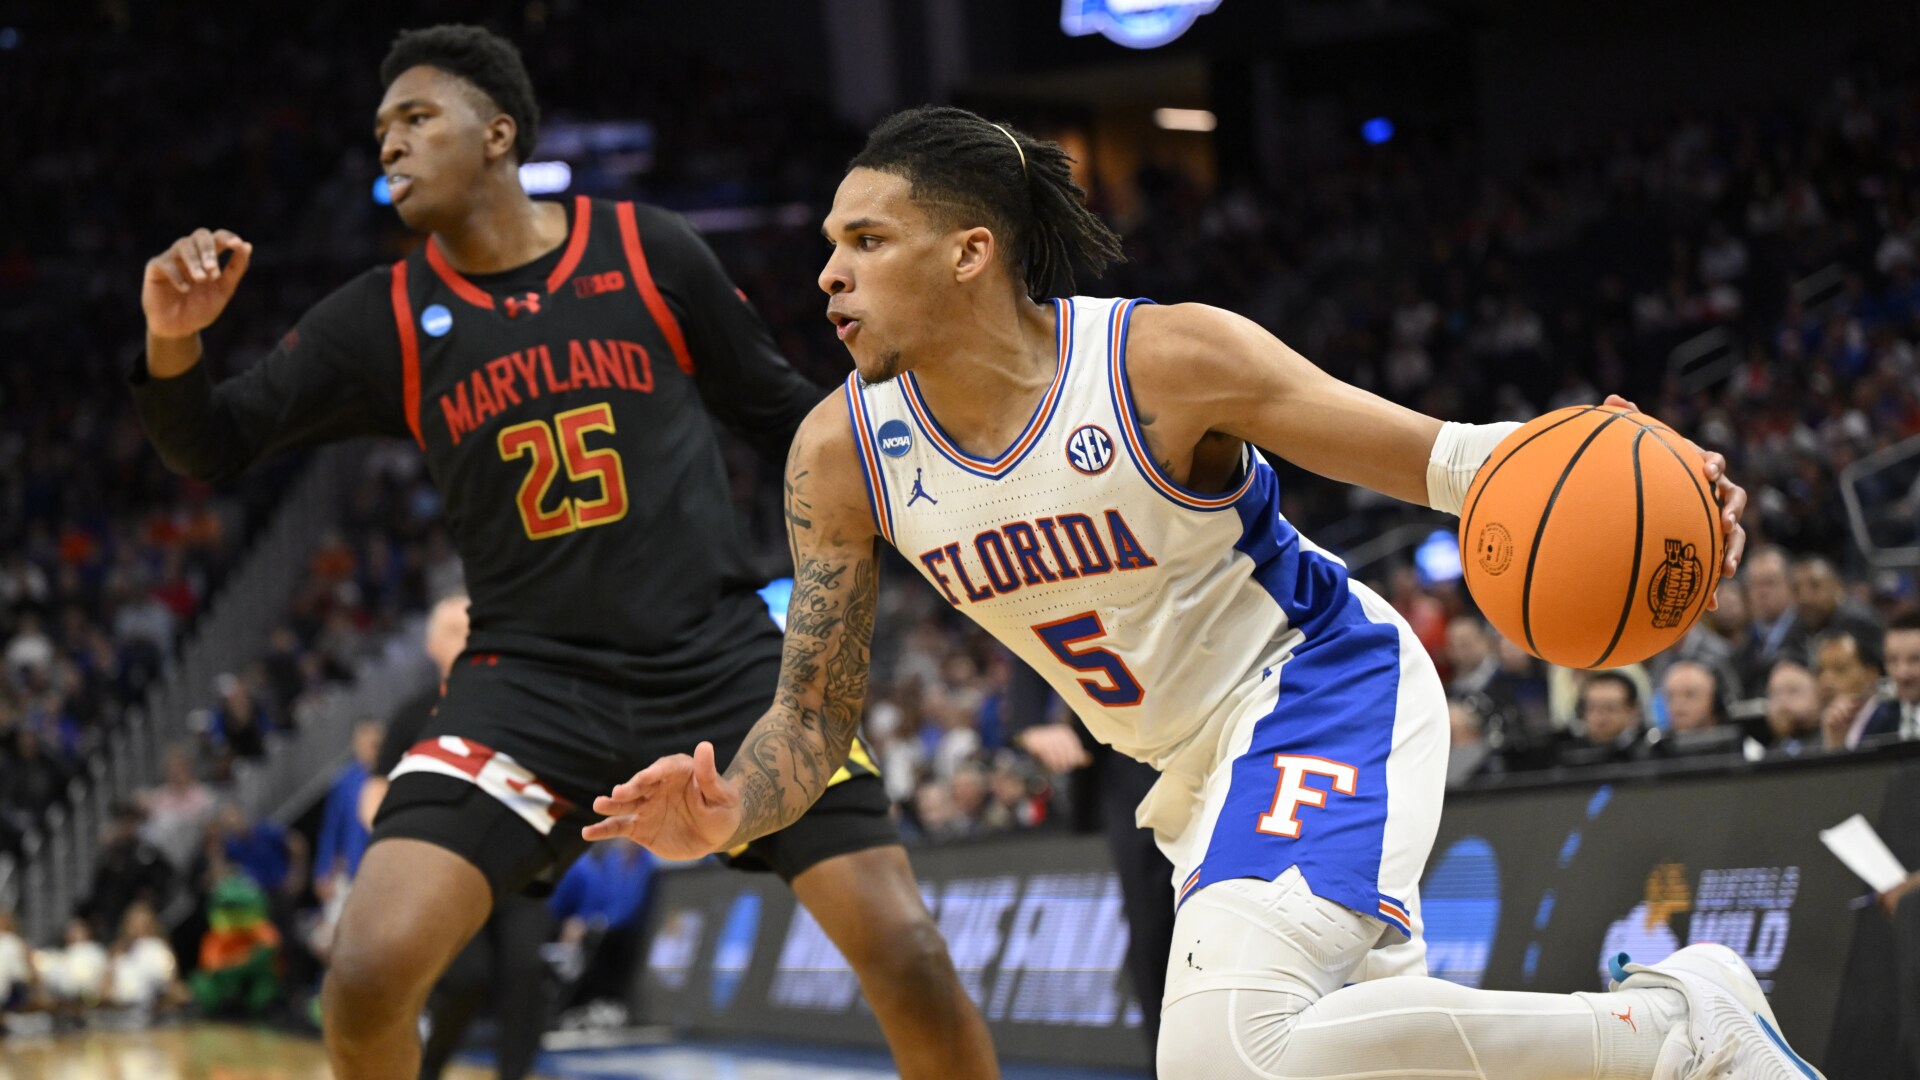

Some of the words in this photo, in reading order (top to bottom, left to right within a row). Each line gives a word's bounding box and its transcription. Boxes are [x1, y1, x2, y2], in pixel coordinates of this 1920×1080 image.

[440, 339, 654, 445] MARYLAND
[497, 402, 628, 540] 25
[883, 436, 910, 449] NCAA
[1070, 428, 1111, 471] SEC
[919, 509, 1158, 606] FLORIDA
[1653, 567, 1681, 628] MADNESS
[1675, 559, 1694, 608] MARCH
[1030, 610, 1145, 707] 5
[1256, 753, 1359, 839] F
